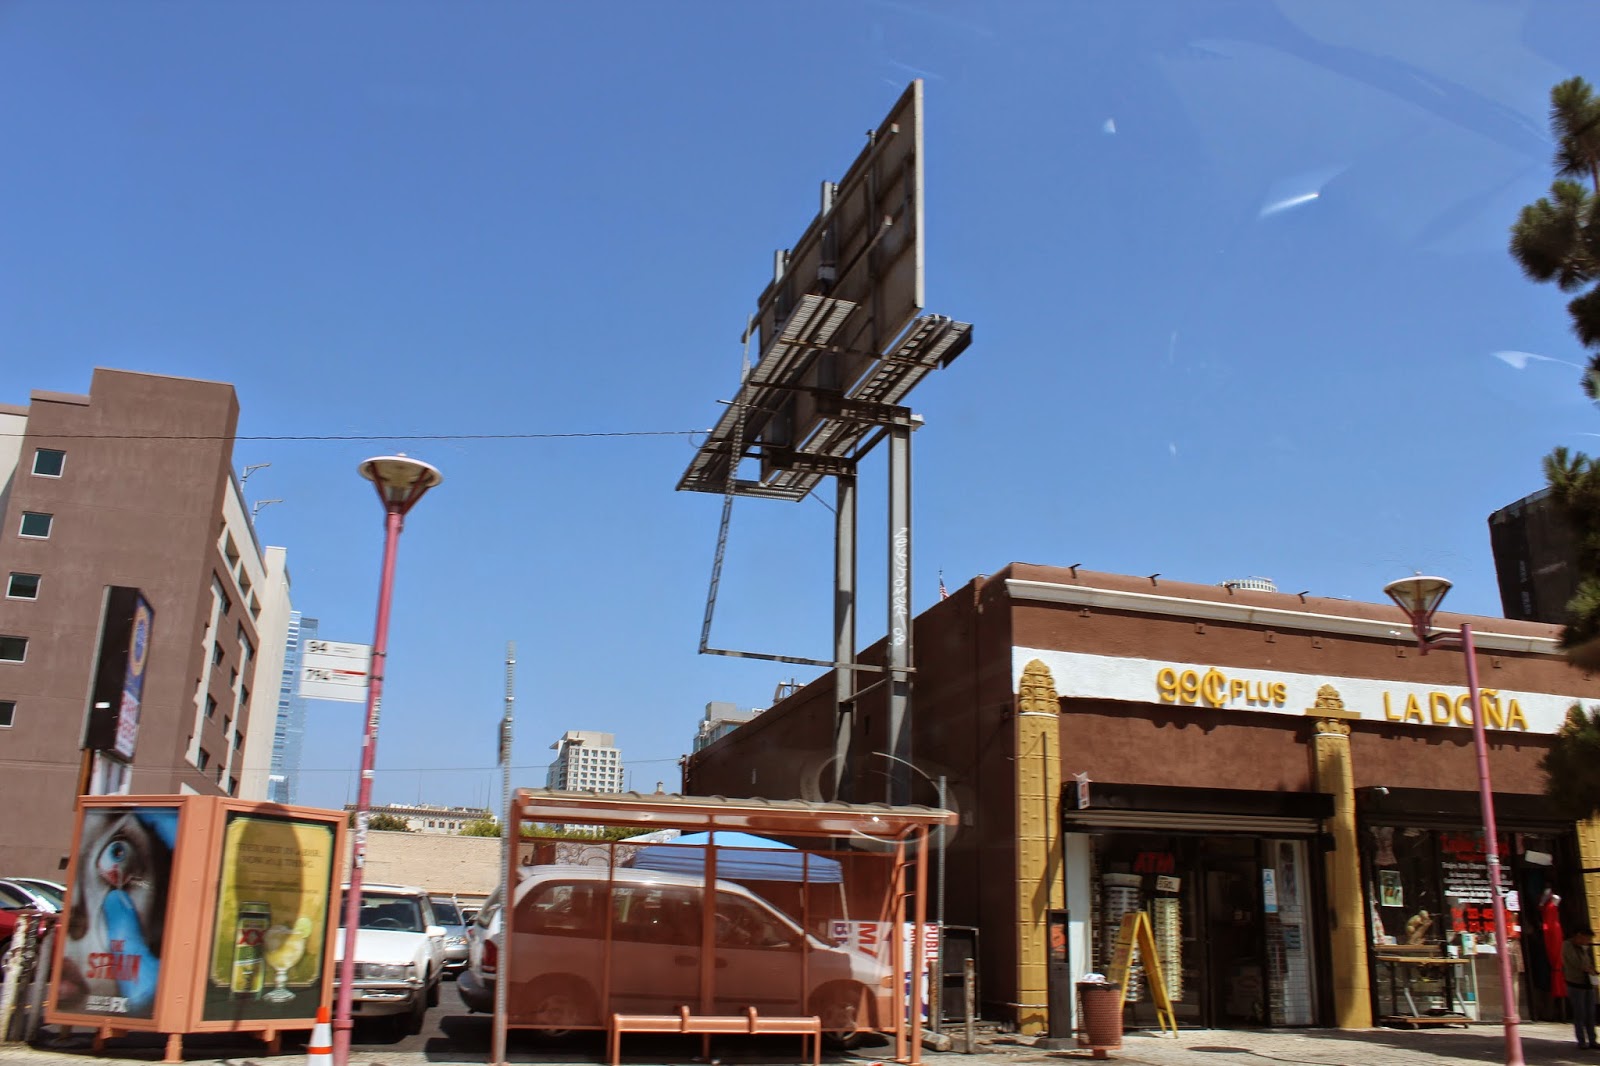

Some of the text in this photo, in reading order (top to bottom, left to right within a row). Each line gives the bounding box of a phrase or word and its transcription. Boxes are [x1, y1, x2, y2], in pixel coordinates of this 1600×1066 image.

[1230, 678, 1288, 704] PLUS
[1383, 688, 1530, 730] LA DOÑA
